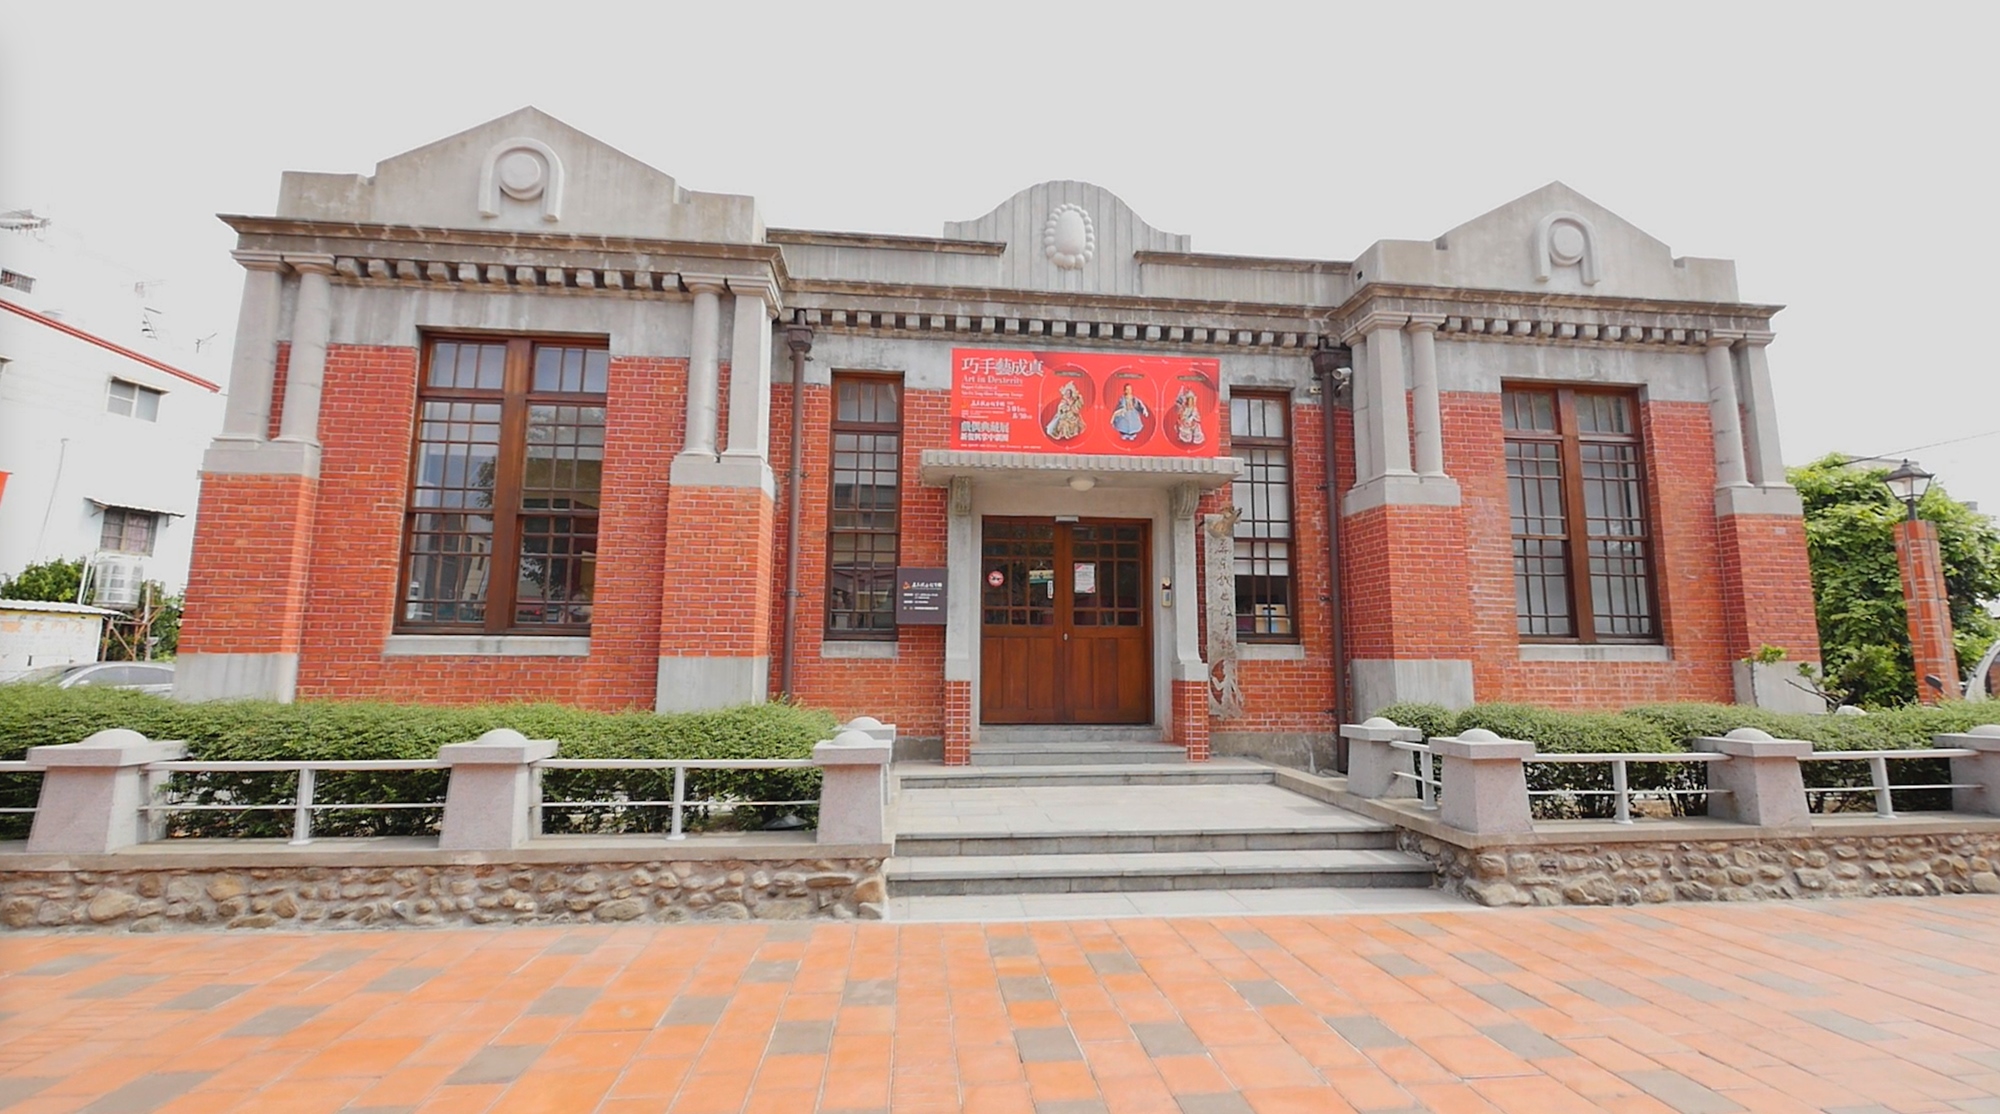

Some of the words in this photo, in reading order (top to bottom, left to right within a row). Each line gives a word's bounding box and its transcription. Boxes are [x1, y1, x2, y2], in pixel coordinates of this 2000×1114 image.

[961, 357, 1044, 377] 巧手藝成真
[963, 375, 975, 383] Art
[977, 375, 985, 383] in
[988, 376, 1023, 386] Dexterity
